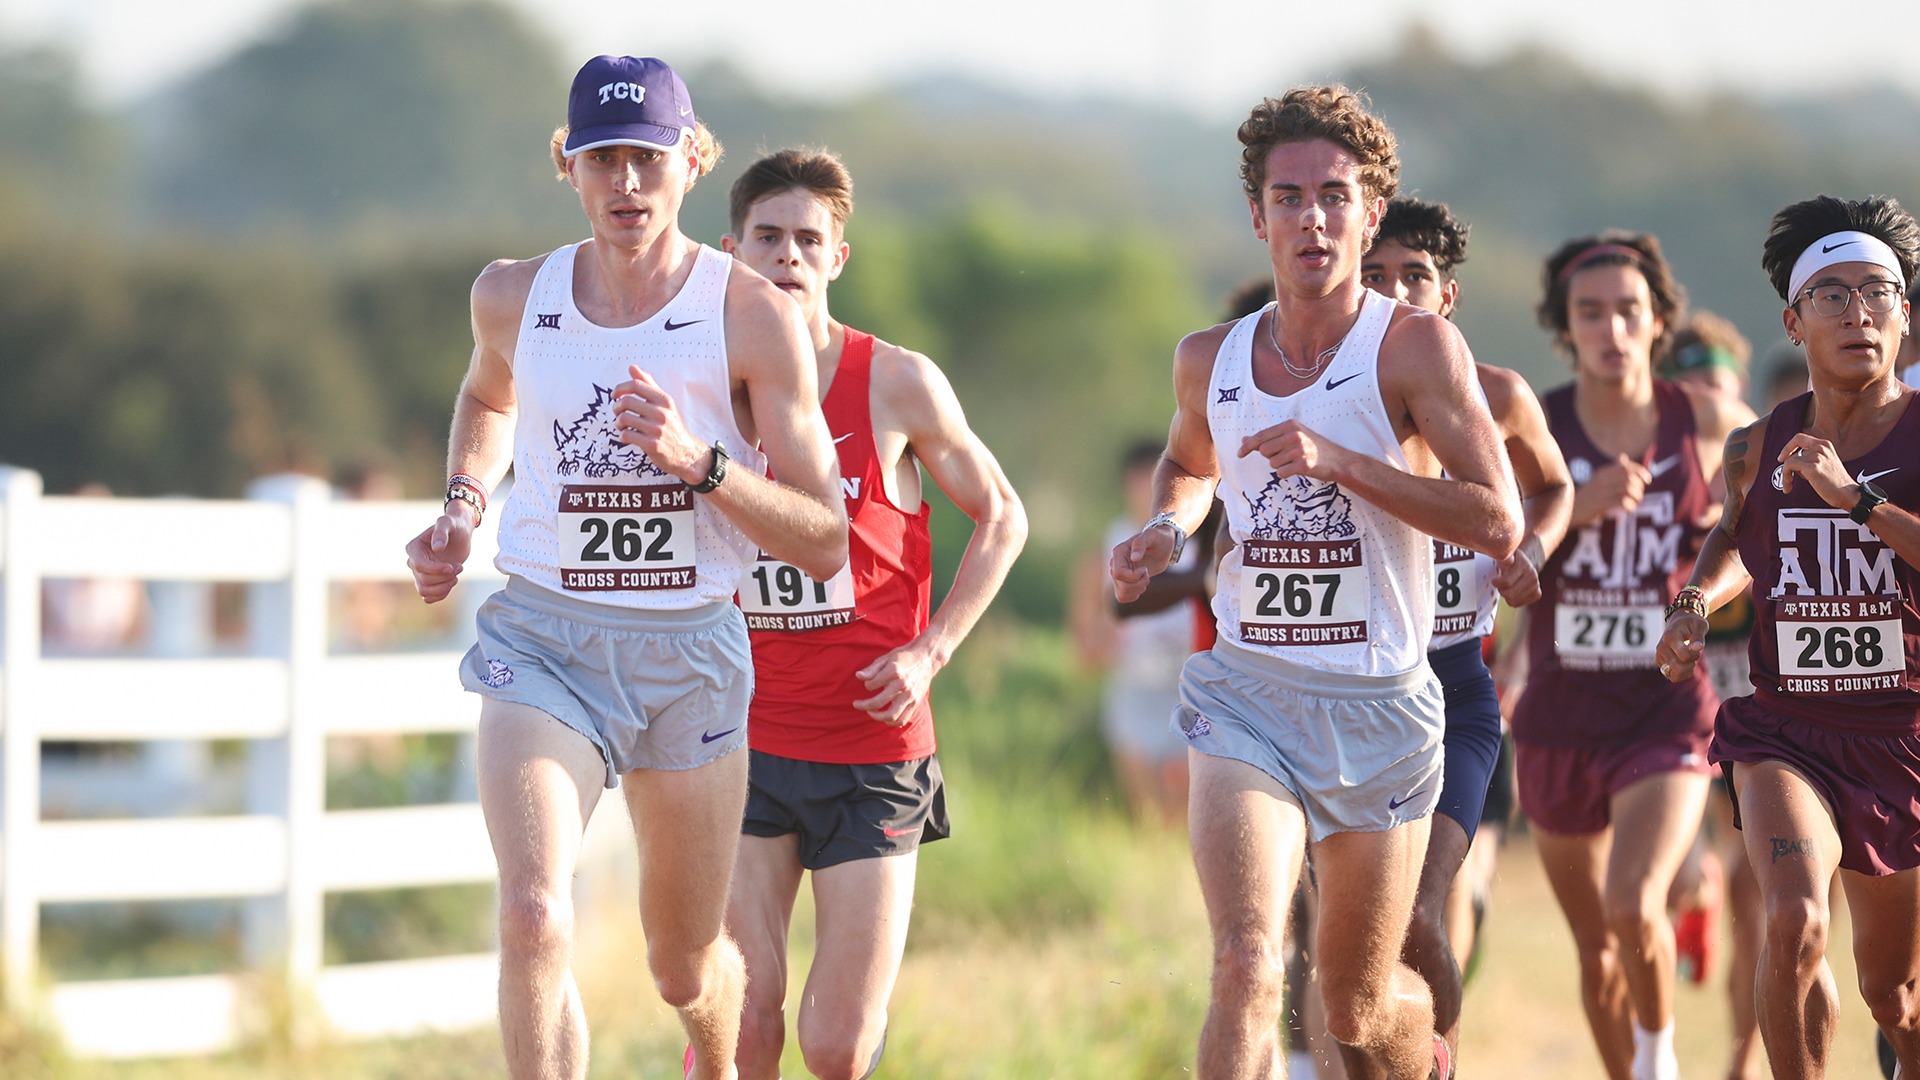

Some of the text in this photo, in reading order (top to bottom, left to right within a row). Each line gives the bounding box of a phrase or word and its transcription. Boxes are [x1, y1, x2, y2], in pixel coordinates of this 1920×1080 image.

[598, 82, 646, 106] TCU
[534, 313, 562, 330] XII
[585, 492, 642, 508] TEXAS
[650, 490, 686, 508] A&M
[580, 517, 674, 562] 262
[1260, 547, 1311, 563] TEXAS
[1318, 547, 1354, 563] A&M
[568, 571, 690, 587] CROSS COUNTRY
[1437, 567, 1461, 608] 8
[1255, 573, 1341, 617] 267
[1799, 602, 1851, 617] TEXAS
[1858, 601, 1893, 617] A&M
[748, 611, 851, 630] CROSS COUNTRY
[1433, 615, 1473, 632] UNTRY
[1247, 625, 1360, 642] CROSS COUNTRY
[1573, 613, 1646, 647] 276
[1795, 626, 1884, 669] 268
[1787, 674, 1900, 692] CROSS COUNTRY
